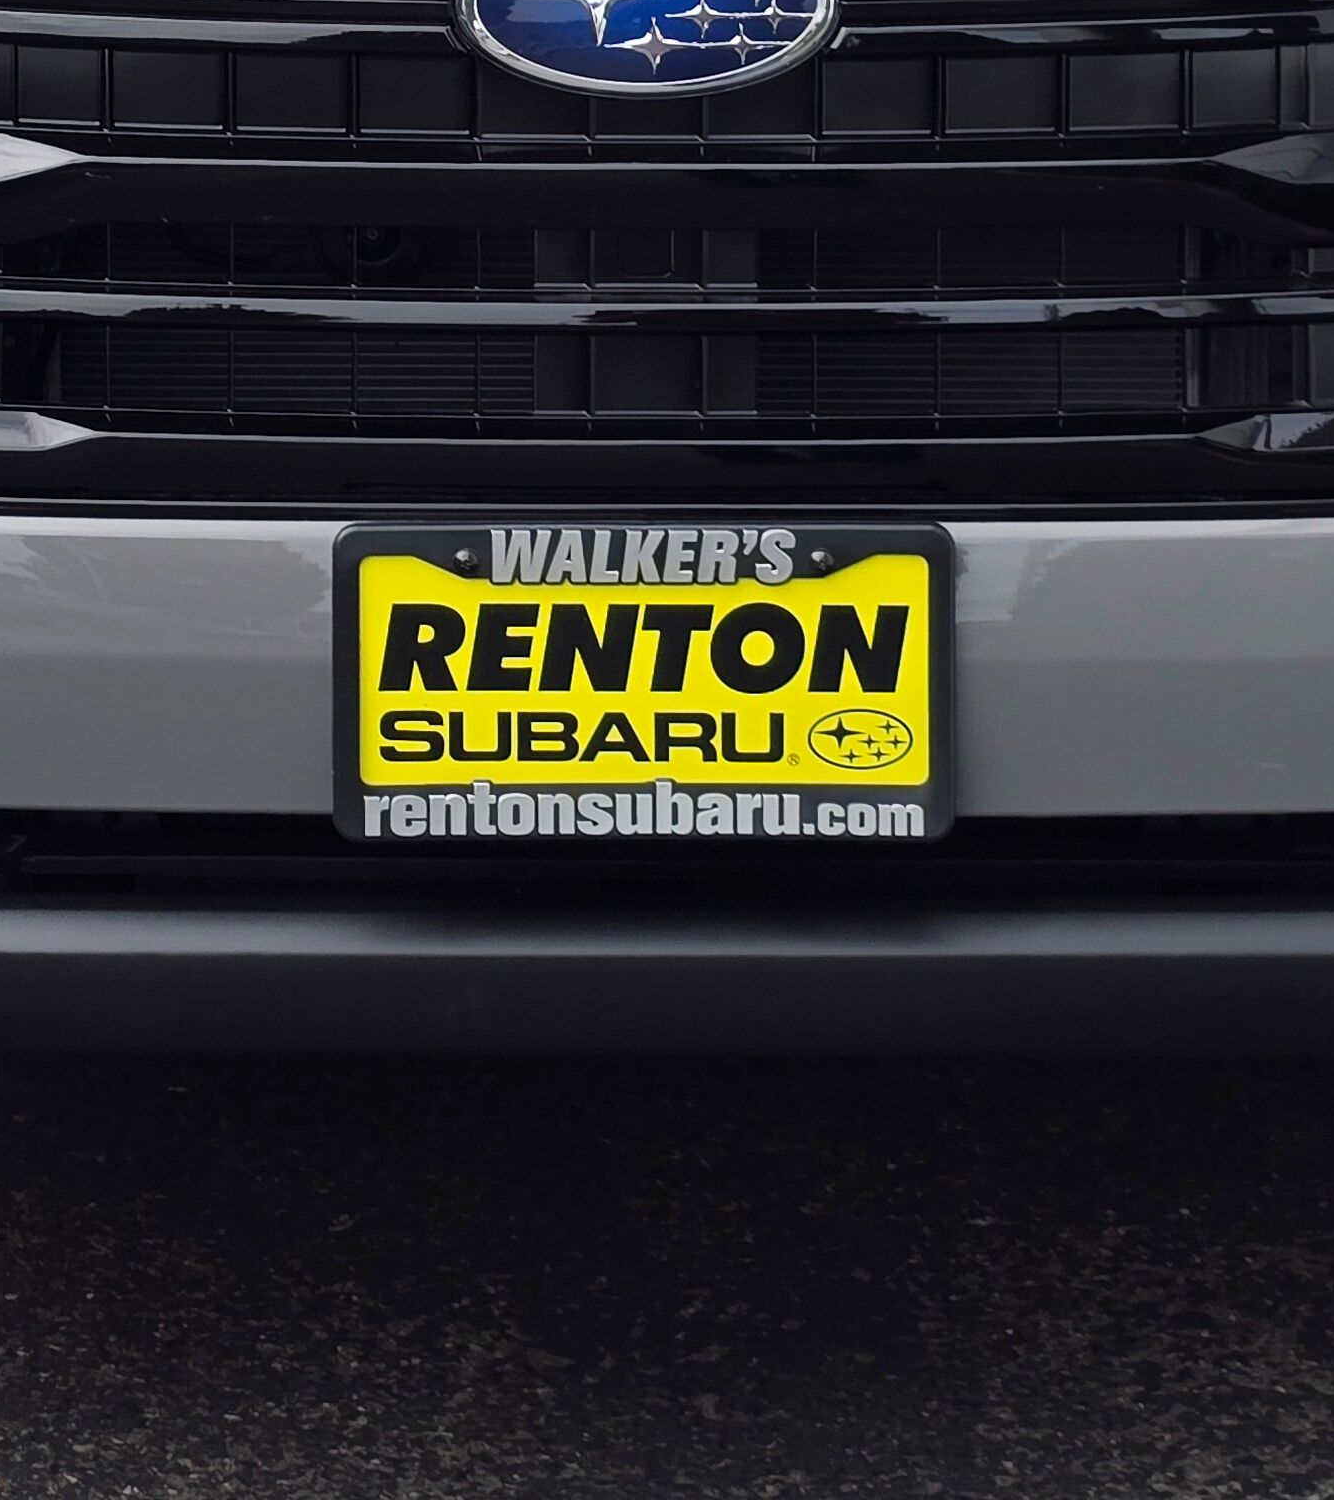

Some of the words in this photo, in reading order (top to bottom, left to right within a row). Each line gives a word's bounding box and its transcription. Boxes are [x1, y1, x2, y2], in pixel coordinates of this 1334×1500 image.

[489, 528, 796, 585] WALKER'S
[377, 602, 910, 694] RENTON
[378, 710, 784, 763] SUBARU
[363, 778, 925, 838] rentonsubaru.com
